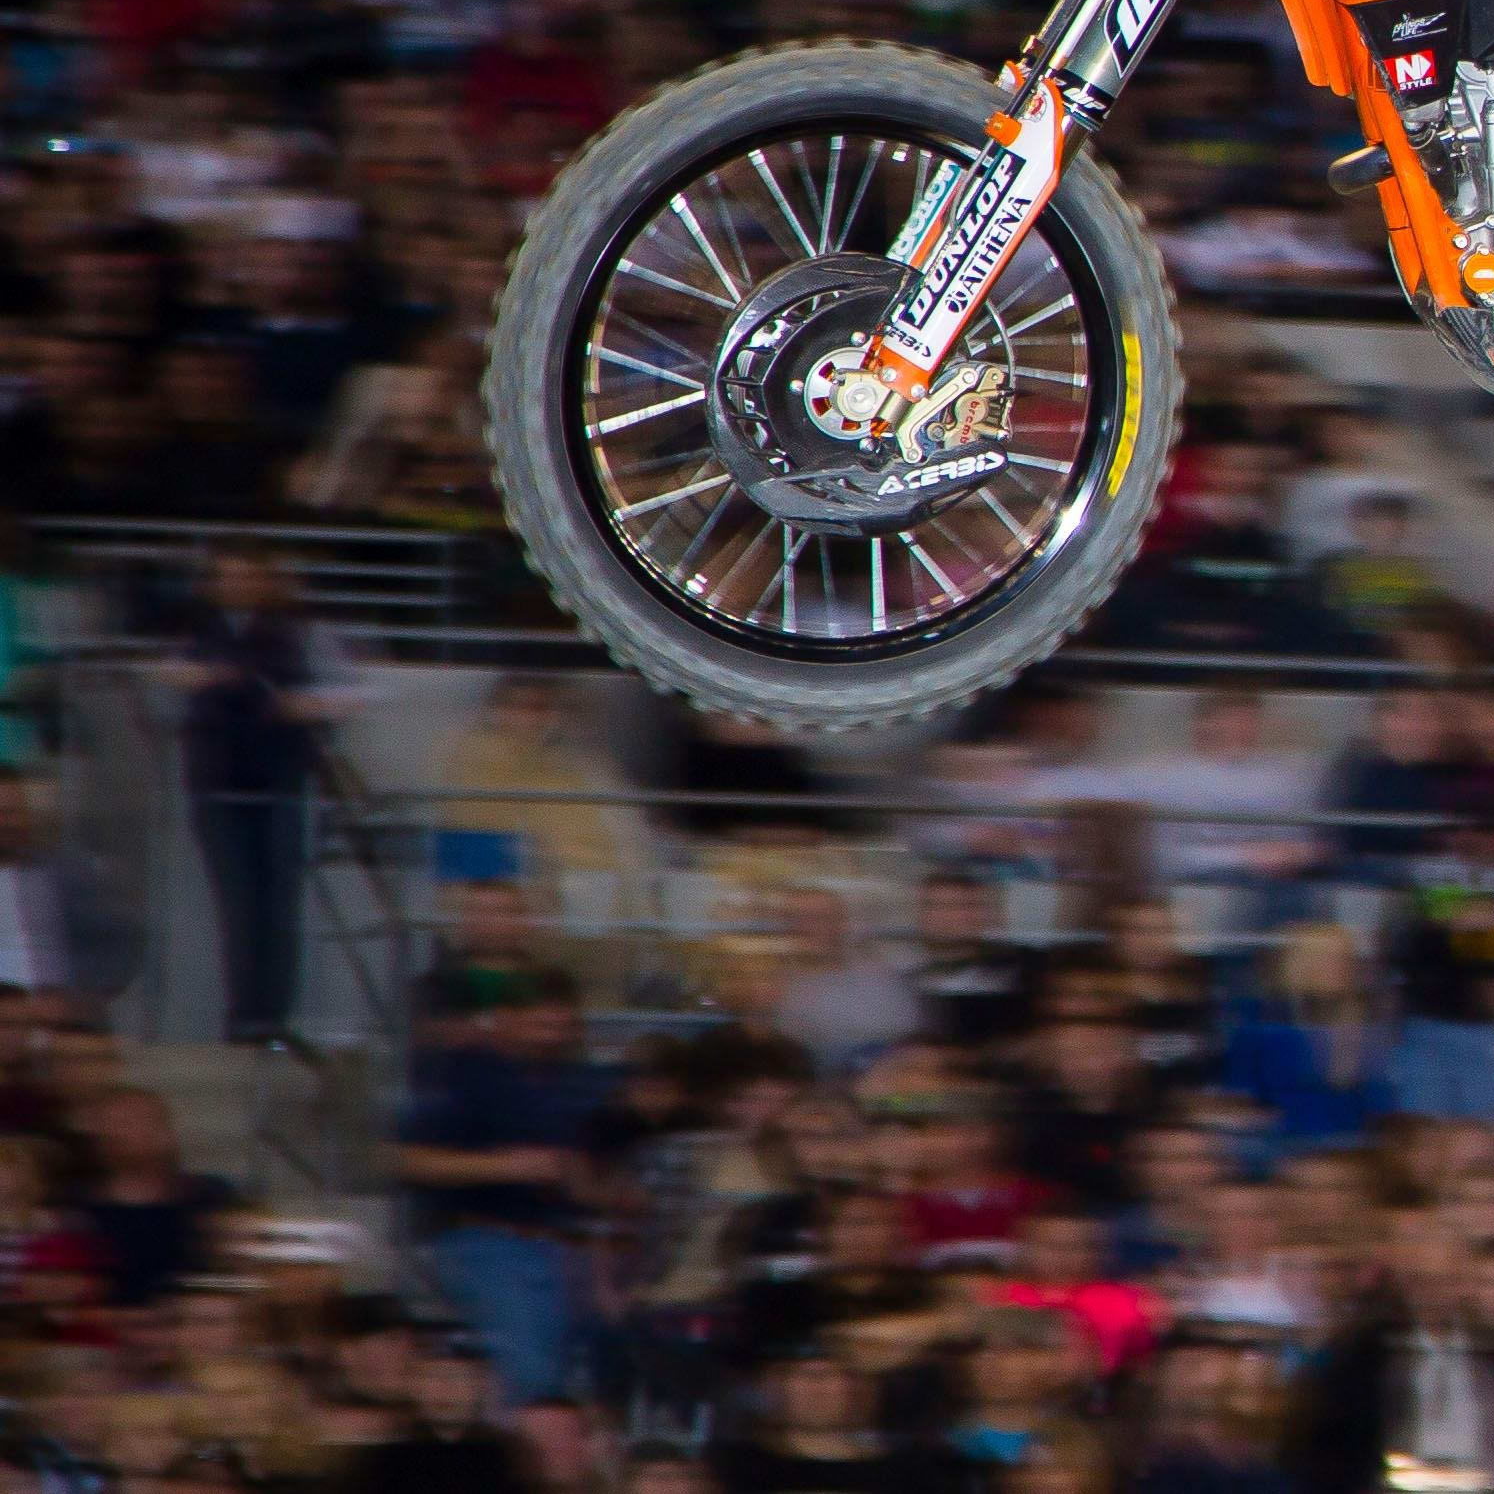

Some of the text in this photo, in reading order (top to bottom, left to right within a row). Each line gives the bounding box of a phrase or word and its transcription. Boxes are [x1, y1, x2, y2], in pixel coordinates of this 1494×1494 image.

[1400, 76, 1433, 91] STYLE
[908, 154, 1013, 328] DUNLOP
[960, 196, 1033, 296] ATHENA
[884, 325, 932, 358] ERBIS
[877, 450, 1006, 496] ACERBIS
